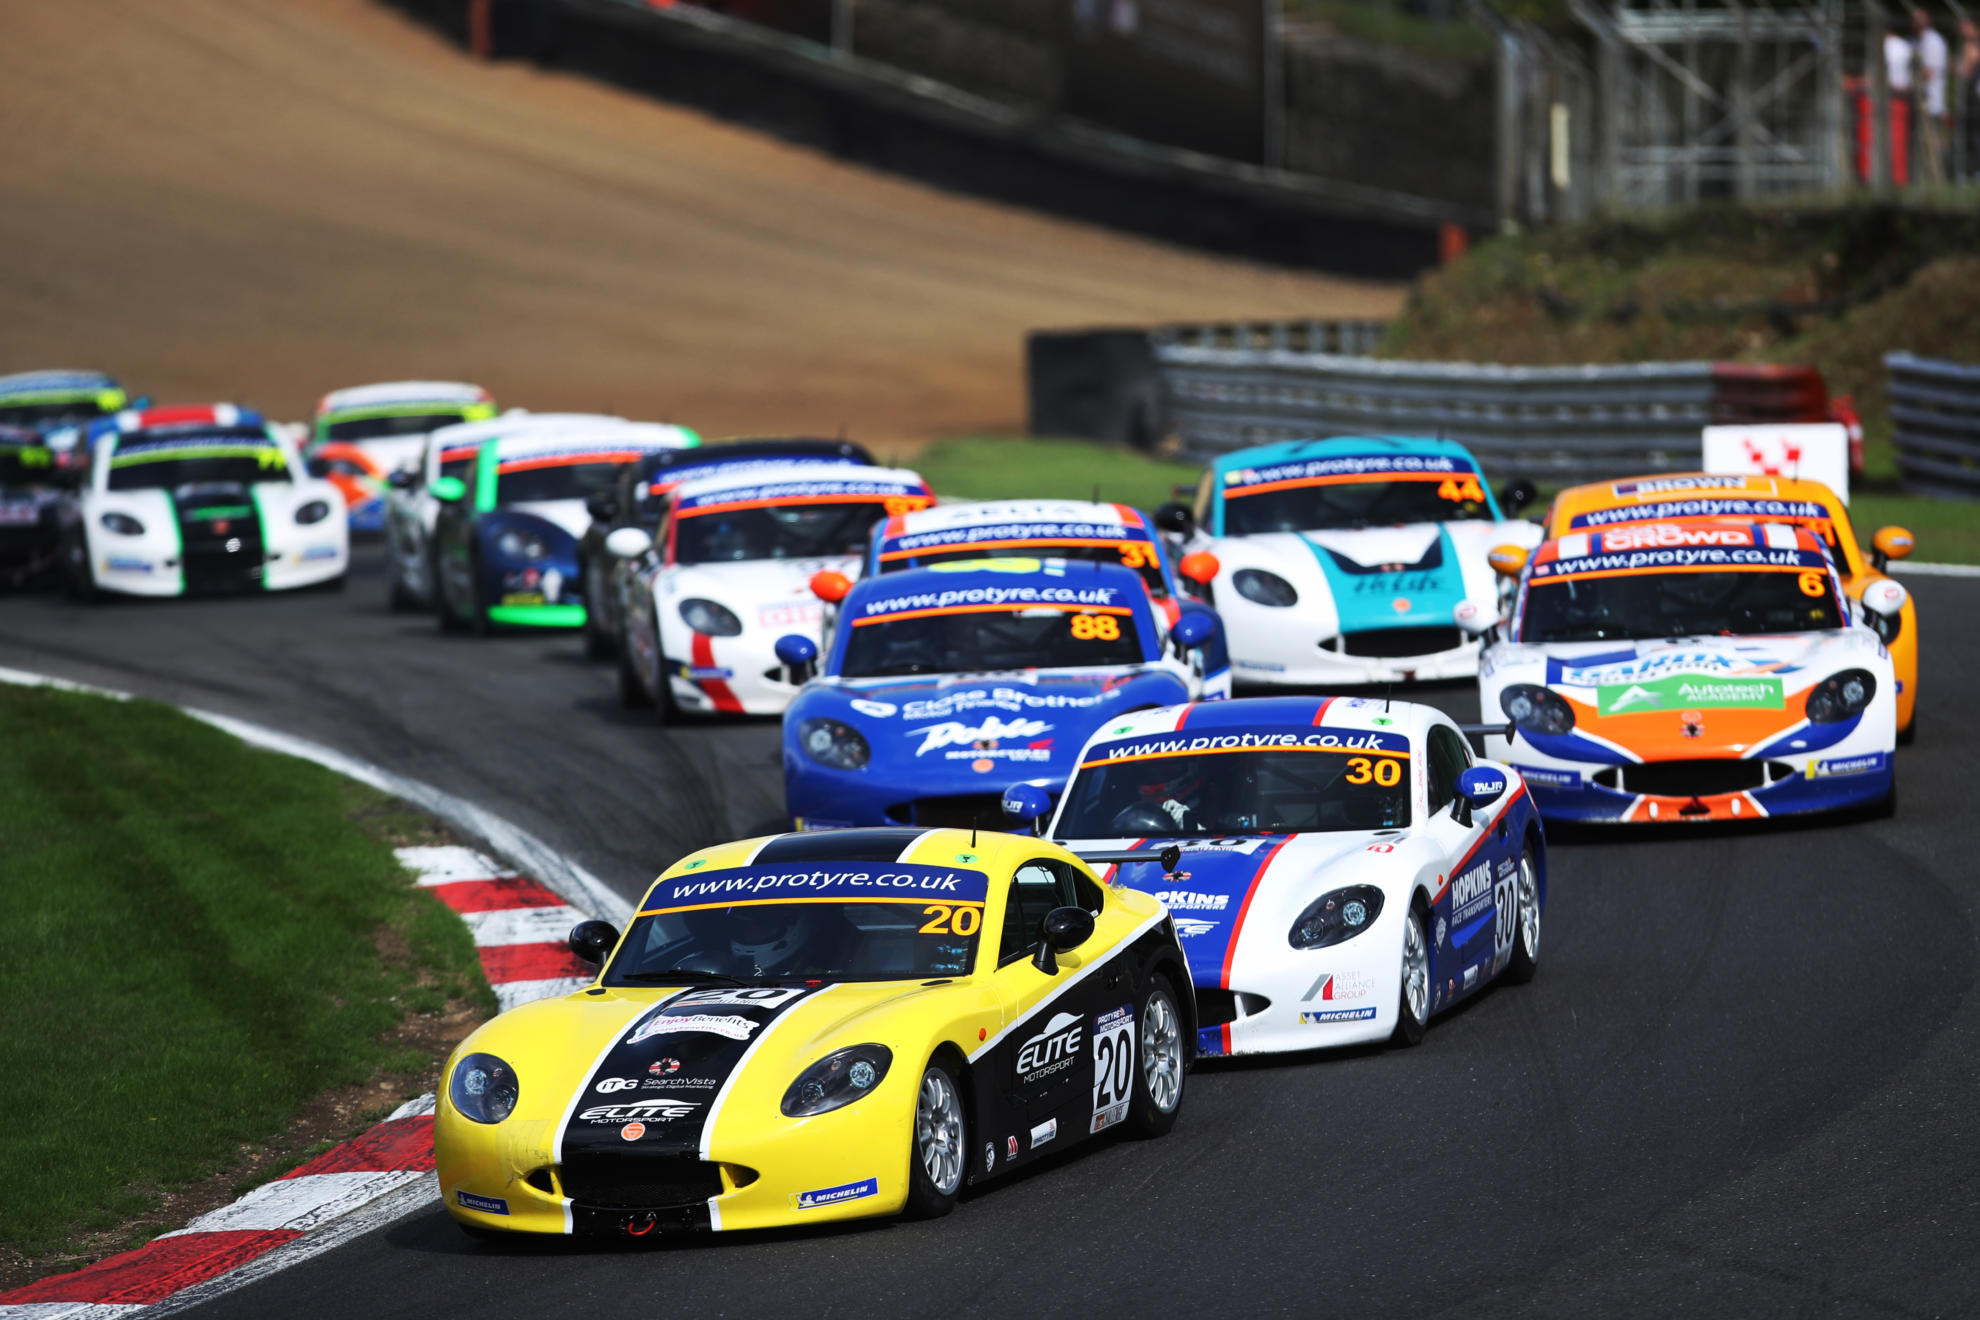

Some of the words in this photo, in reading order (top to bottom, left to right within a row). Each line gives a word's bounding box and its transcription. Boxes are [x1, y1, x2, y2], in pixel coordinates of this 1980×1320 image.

[1438, 478, 1485, 502] 44
[1587, 499, 1819, 526] www.protyre.co.uk
[900, 524, 1127, 550] www.protyre.co.uk
[1118, 543, 1160, 568] 31
[1555, 549, 1800, 574] www.protyre.co.uk
[1798, 572, 1825, 597] 6
[866, 586, 1117, 615] www.protyre.co.uk
[1071, 614, 1120, 641] 88
[1678, 682, 1774, 696] Autotech
[1109, 732, 1384, 759] www.protyre.co.uk
[1345, 757, 1401, 787] 30
[1473, 780, 1504, 794] WJR
[672, 870, 962, 899] www.protyre.co.uk
[1452, 859, 1492, 910] HOPKINS
[1154, 890, 1230, 905] PKINS
[918, 905, 981, 936] 20
[1497, 880, 1513, 949] 30
[1333, 989, 1366, 1000] GROUP
[653, 1014, 750, 1029] EnjoyBenefits
[1320, 1009, 1373, 1021] MICHELIN
[1016, 1026, 1083, 1075] ELITE
[1023, 1056, 1075, 1085] MOTORSPORT
[1096, 1029, 1131, 1109] 20
[643, 1078, 717, 1086] SearchVista
[579, 1106, 695, 1120] ELITE
[465, 1198, 501, 1211] MICHELIN
[815, 1185, 869, 1202] MICHELIN
